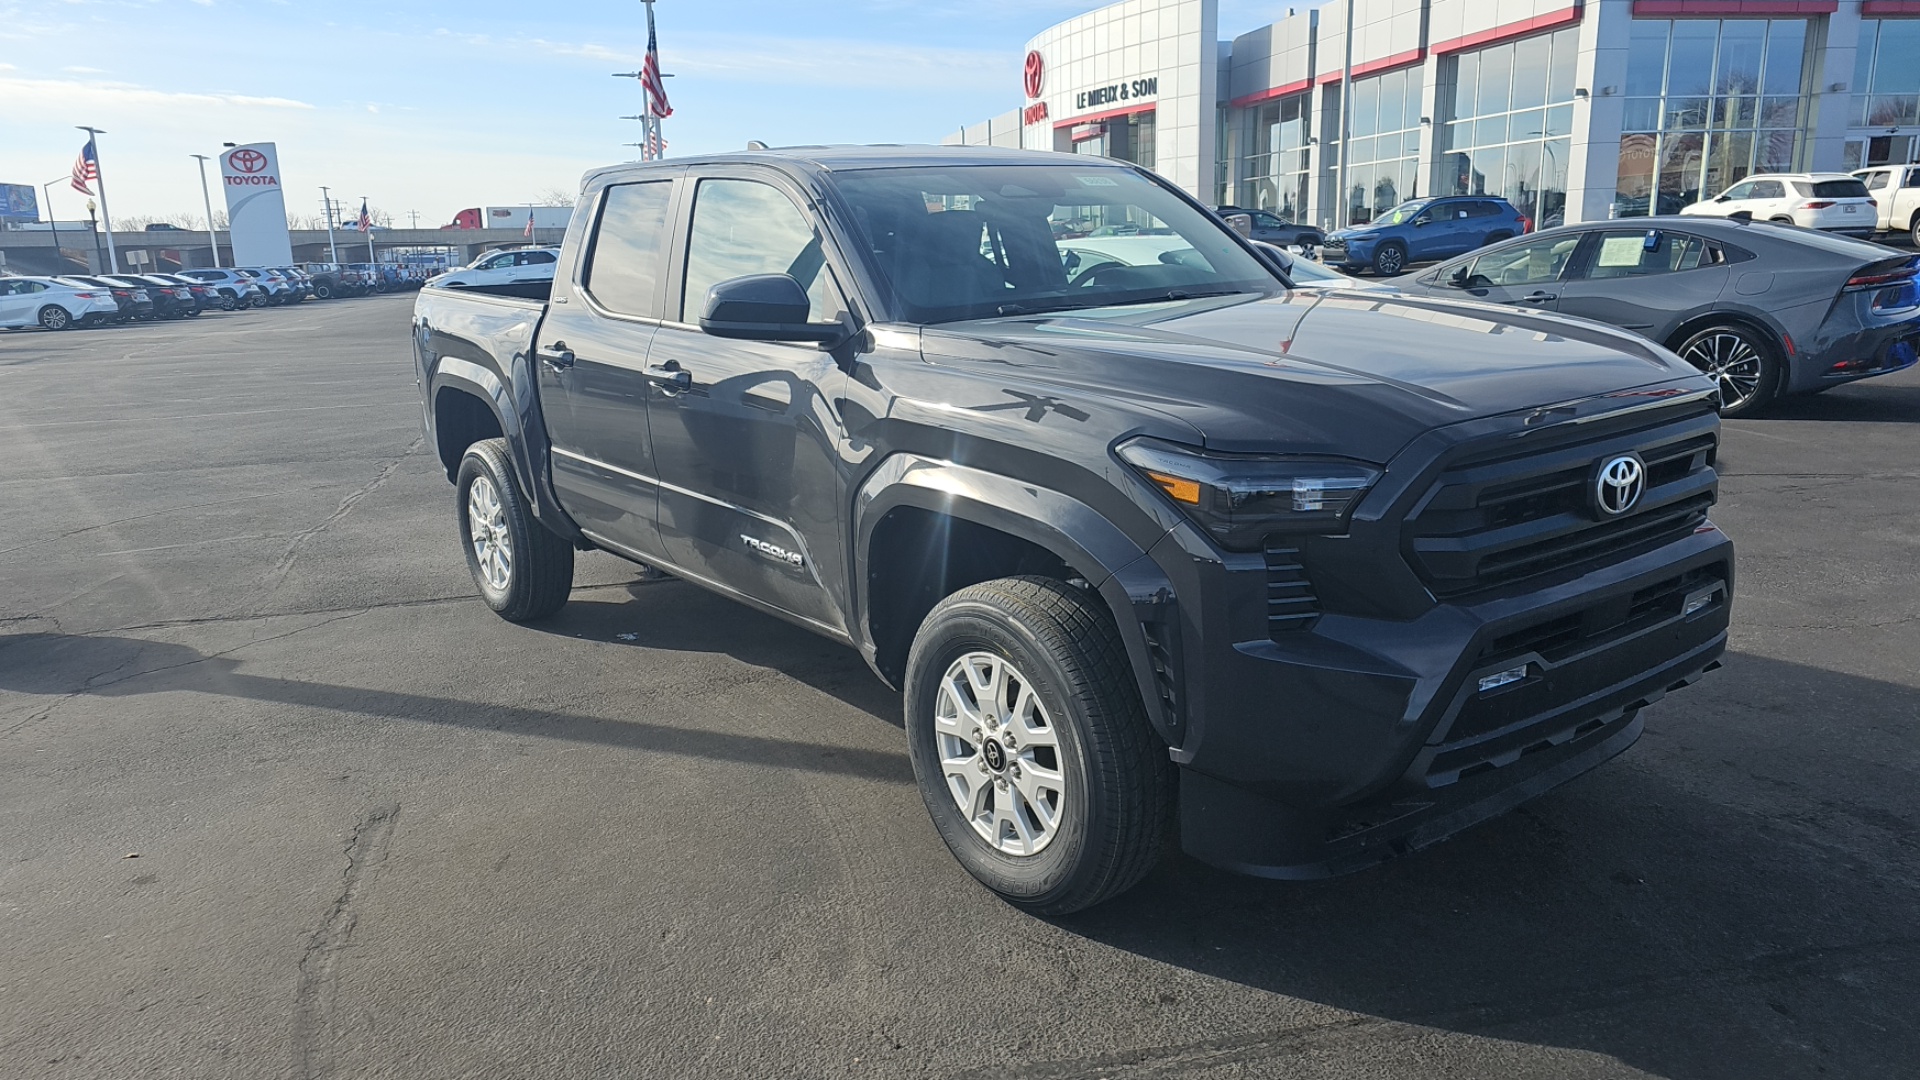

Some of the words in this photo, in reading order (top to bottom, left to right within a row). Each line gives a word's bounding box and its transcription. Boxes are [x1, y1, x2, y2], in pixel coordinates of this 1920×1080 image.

[1077, 92, 1087, 110] LE
[1088, 85, 1118, 107] MIEUX
[1120, 82, 1129, 100] &
[1132, 77, 1158, 98] SON
[1024, 101, 1049, 126] TOYOTA
[1627, 148, 1657, 160] TOYOT
[224, 175, 277, 186] TOYOTA
[1158, 458, 1191, 469] TACOMA
[739, 533, 804, 566] TACOMA
